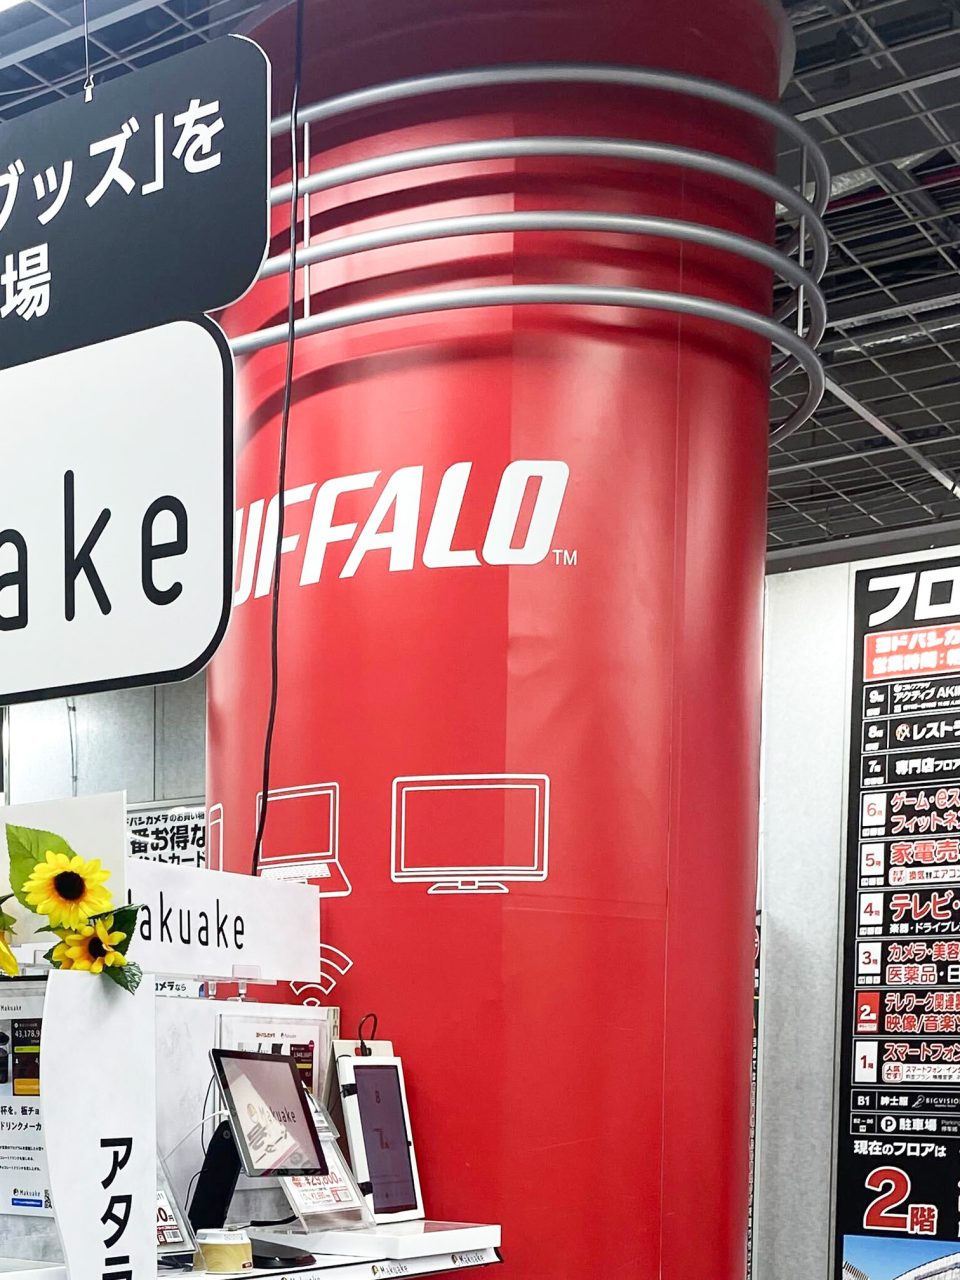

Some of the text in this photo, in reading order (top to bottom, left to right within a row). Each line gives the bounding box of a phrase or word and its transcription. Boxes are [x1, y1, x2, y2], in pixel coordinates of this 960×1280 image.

[128, 889, 245, 950] akuake
[857, 1095, 870, 1106] B1
[899, 1118, 937, 1132] 駐車場
[853, 1140, 947, 1158] 現在のフロアは
[863, 1165, 938, 1235] 2階
[460, 1252, 485, 1264] Makuake
[380, 1263, 408, 1276] Makuake
